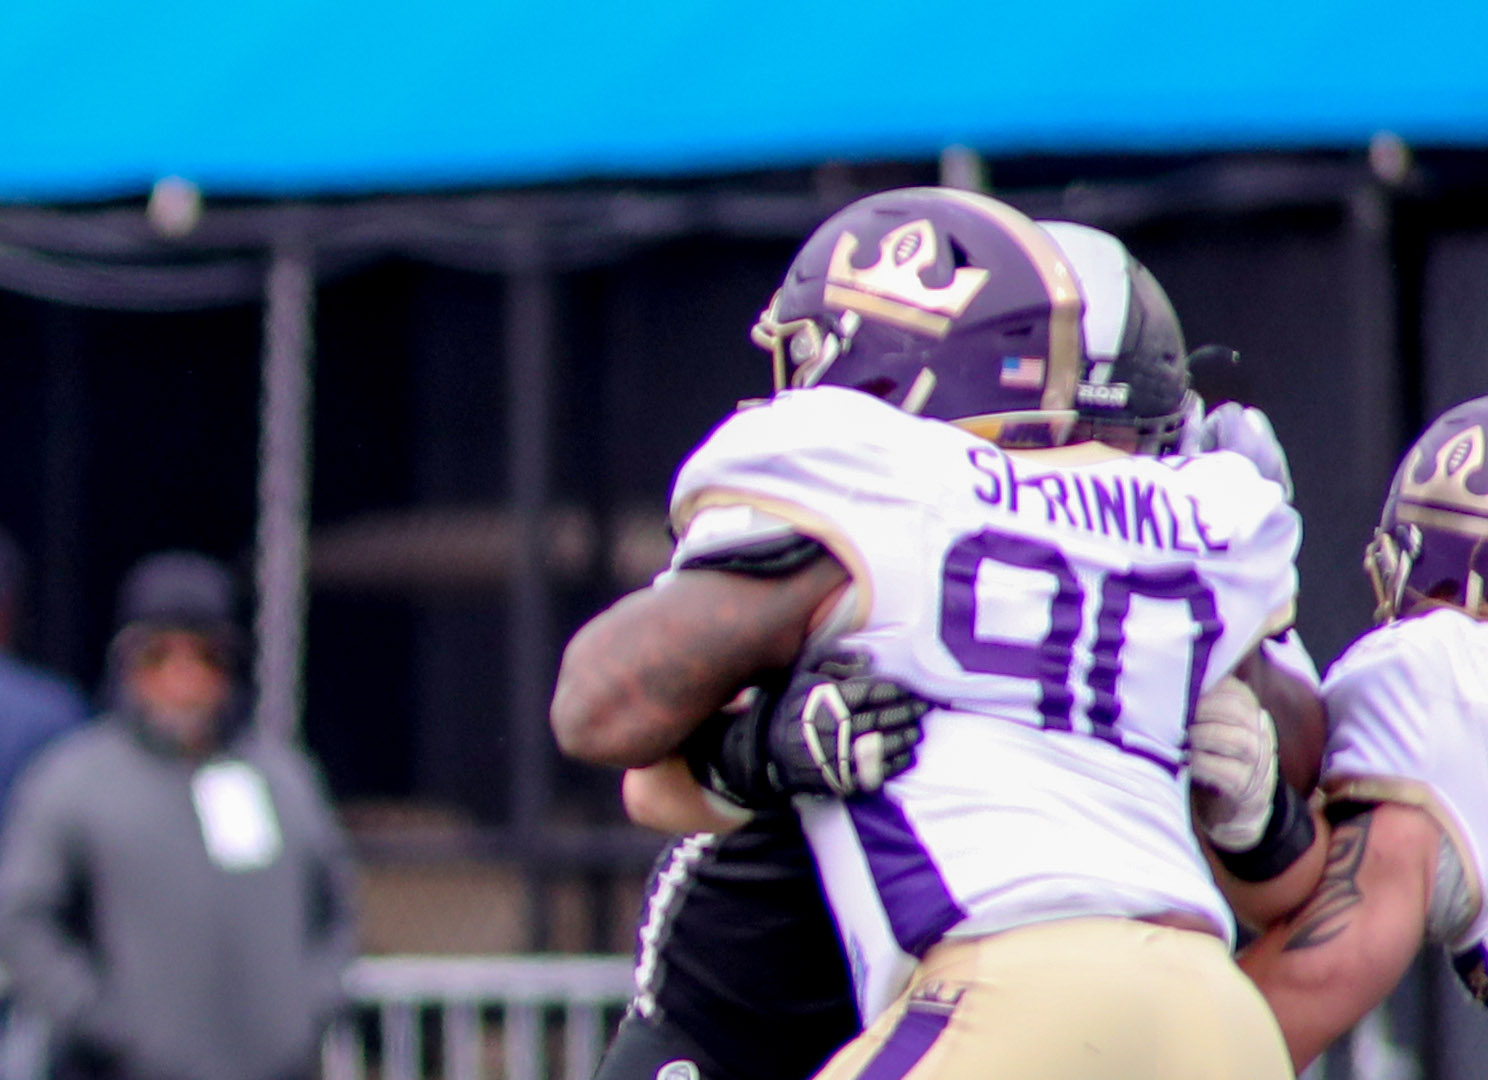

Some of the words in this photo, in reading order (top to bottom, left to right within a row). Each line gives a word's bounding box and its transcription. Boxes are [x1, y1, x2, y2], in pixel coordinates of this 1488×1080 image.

[1077, 384, 1129, 407] RON
[966, 446, 1229, 553] SPRINKLE
[940, 522, 1225, 783] 90
